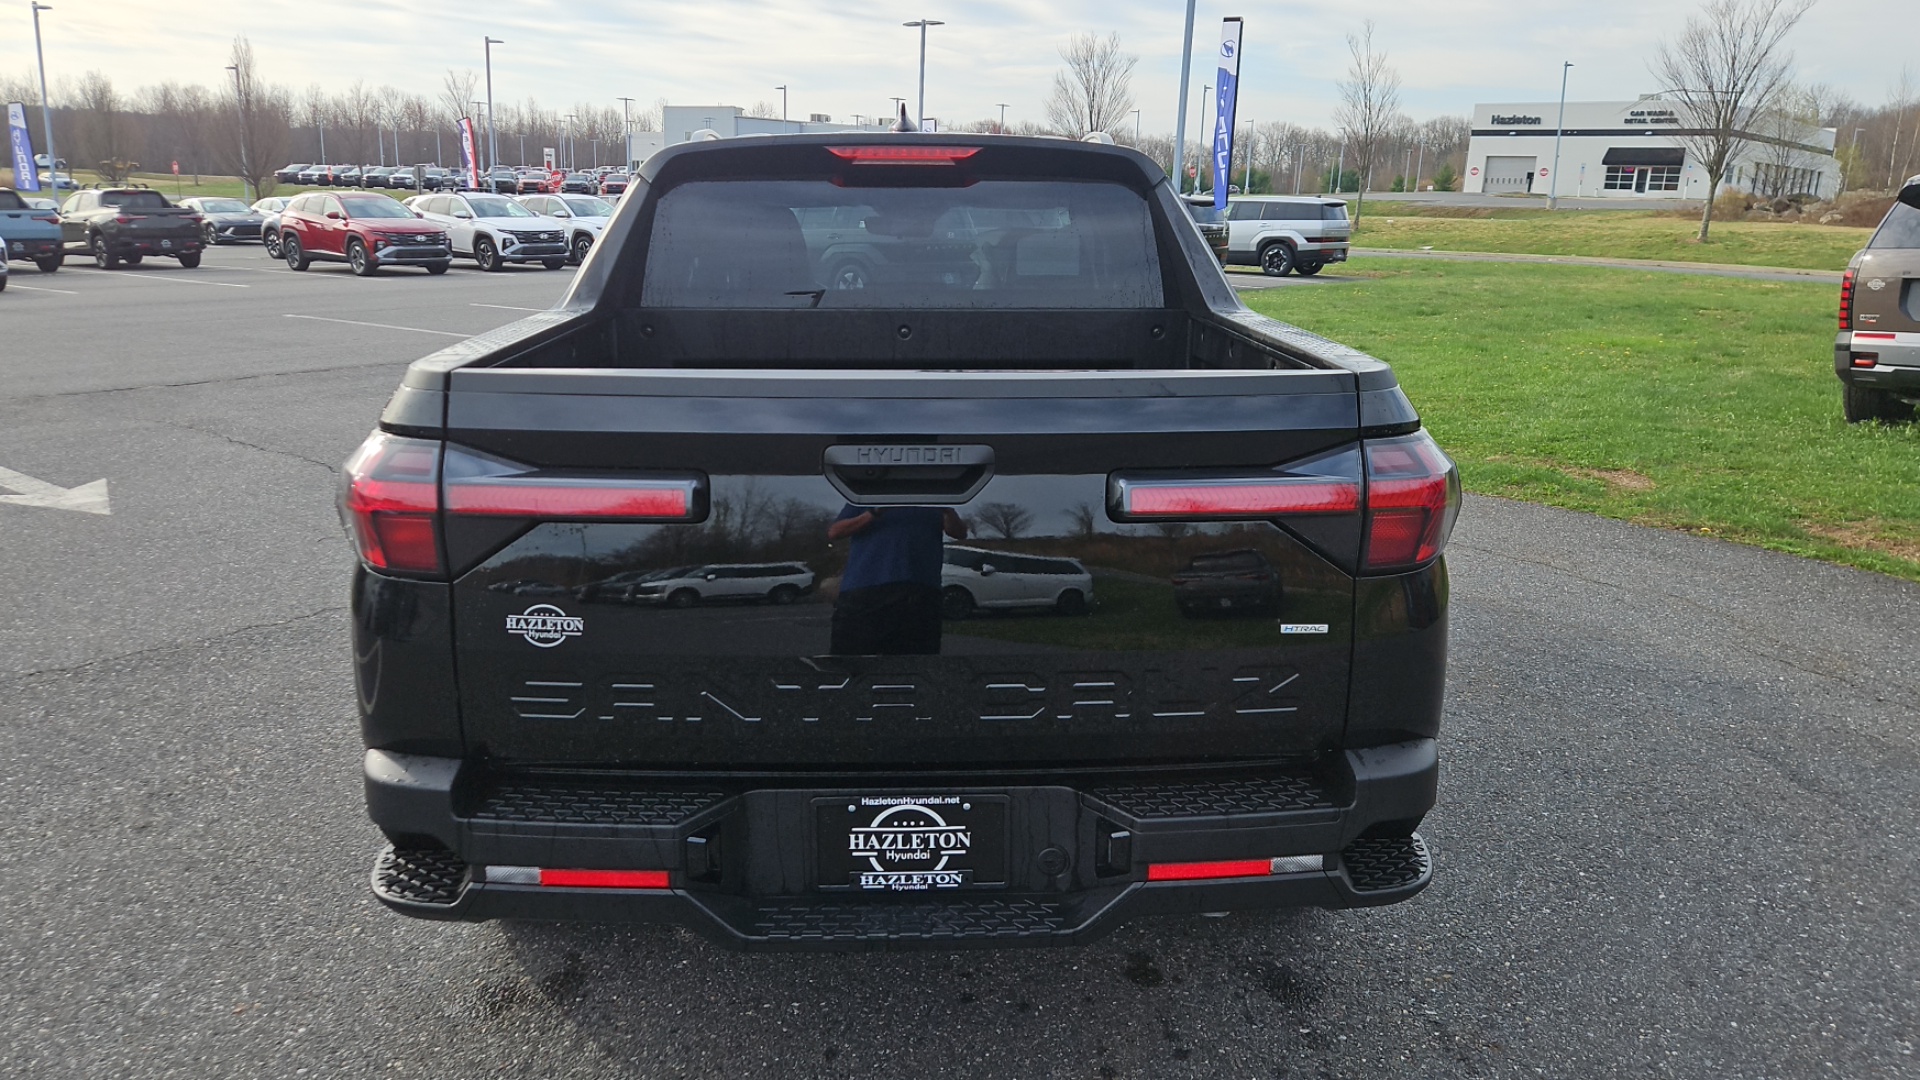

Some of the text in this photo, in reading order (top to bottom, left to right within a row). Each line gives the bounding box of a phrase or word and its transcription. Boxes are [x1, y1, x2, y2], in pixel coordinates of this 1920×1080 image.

[1491, 115, 1541, 125] Hazleton
[857, 447, 962, 463] HYUNDAI
[506, 617, 584, 631] HAZLETON
[528, 630, 561, 640] Hyundai
[509, 665, 1301, 722] SANTA CRUZ
[861, 796, 961, 806] HazletonHyundai.net
[849, 832, 971, 850] HAZLETON
[886, 849, 930, 862] Hyundai
[860, 873, 963, 885] HAZLETON
[892, 883, 928, 891] Hyundai
